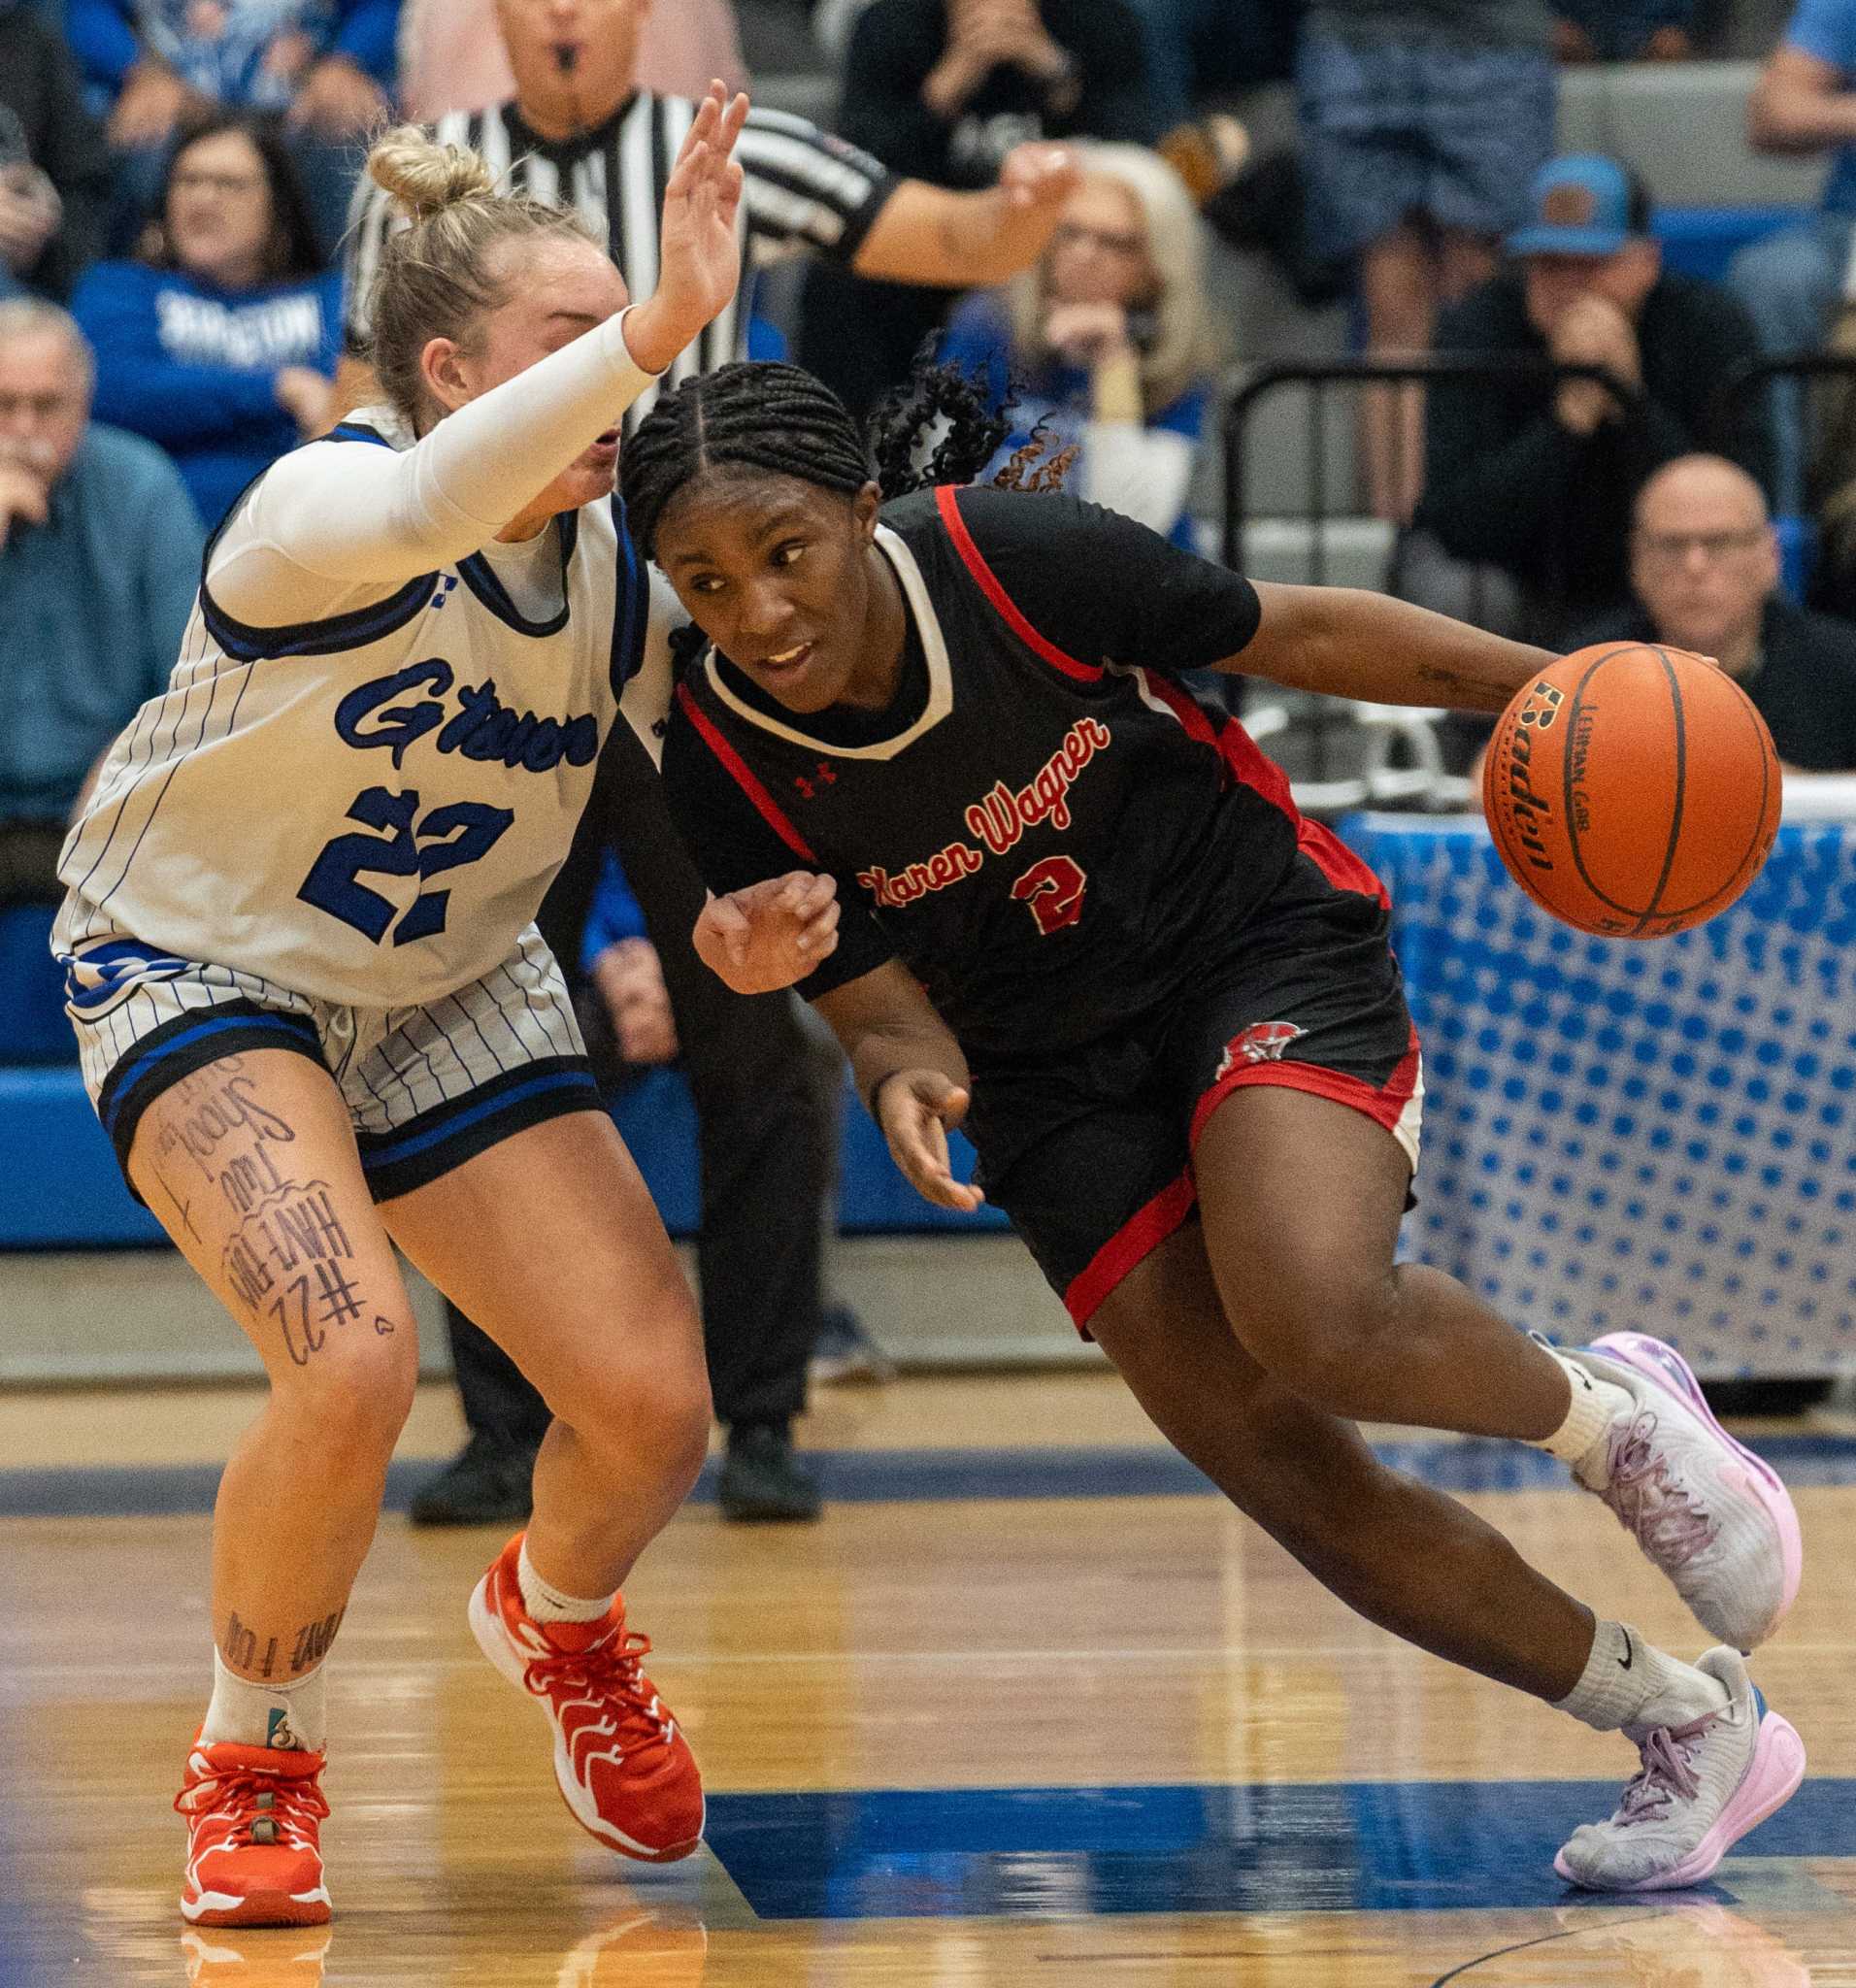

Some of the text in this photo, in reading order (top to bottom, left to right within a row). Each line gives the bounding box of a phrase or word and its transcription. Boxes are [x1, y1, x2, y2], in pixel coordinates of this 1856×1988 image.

[857, 717, 1110, 908] Karen Wagner
[1509, 681, 1565, 870] Baden
[295, 785, 514, 947] 22
[1010, 854, 1088, 936] 2
[269, 1258, 368, 1366] #22
